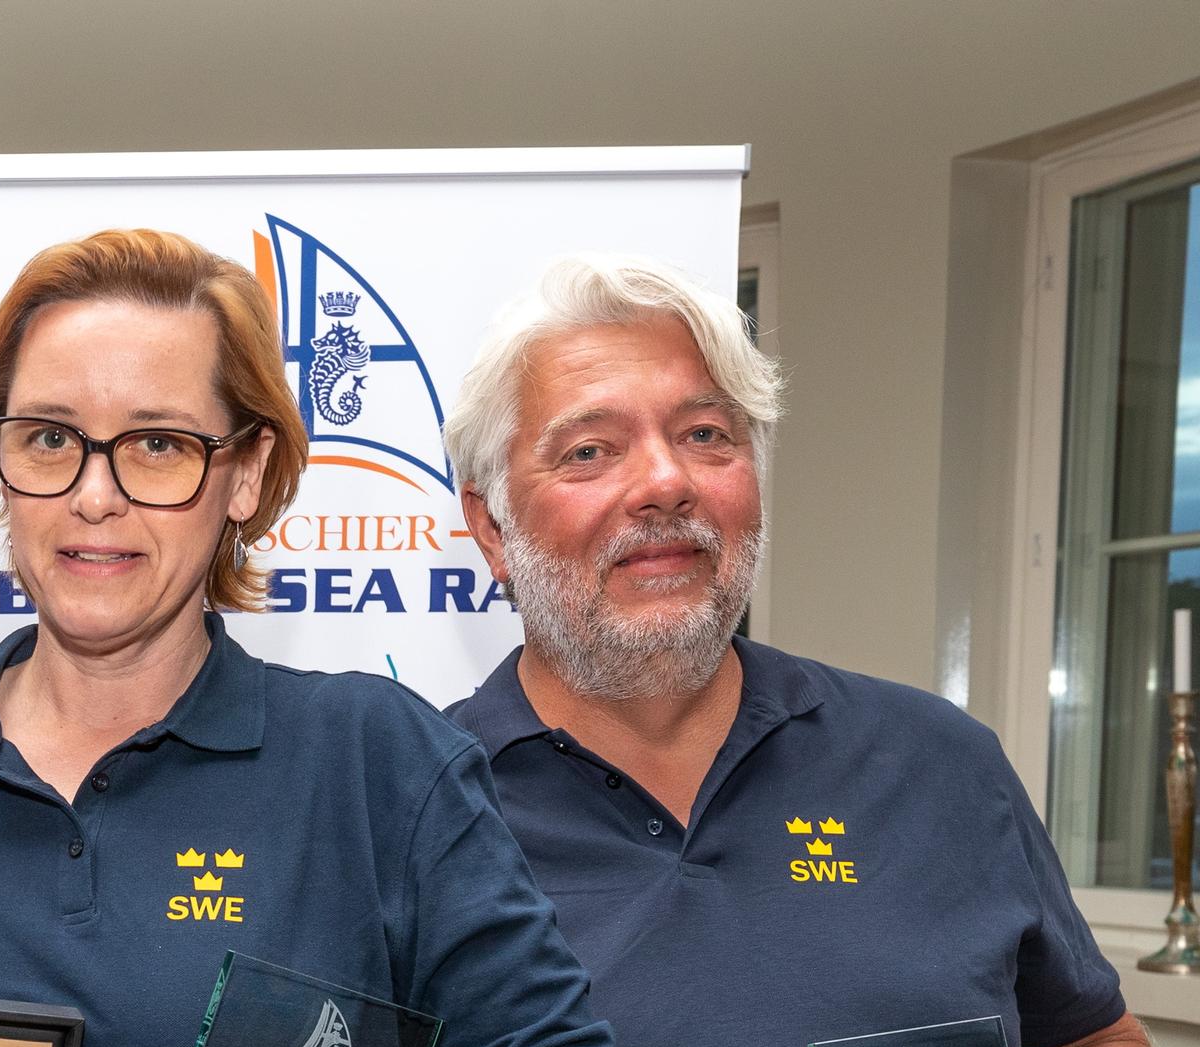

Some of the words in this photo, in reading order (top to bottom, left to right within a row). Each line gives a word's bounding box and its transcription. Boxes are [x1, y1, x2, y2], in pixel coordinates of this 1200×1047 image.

[265, 568, 407, 613] SEA
[789, 860, 859, 884] SWE
[166, 895, 245, 923] SWE
